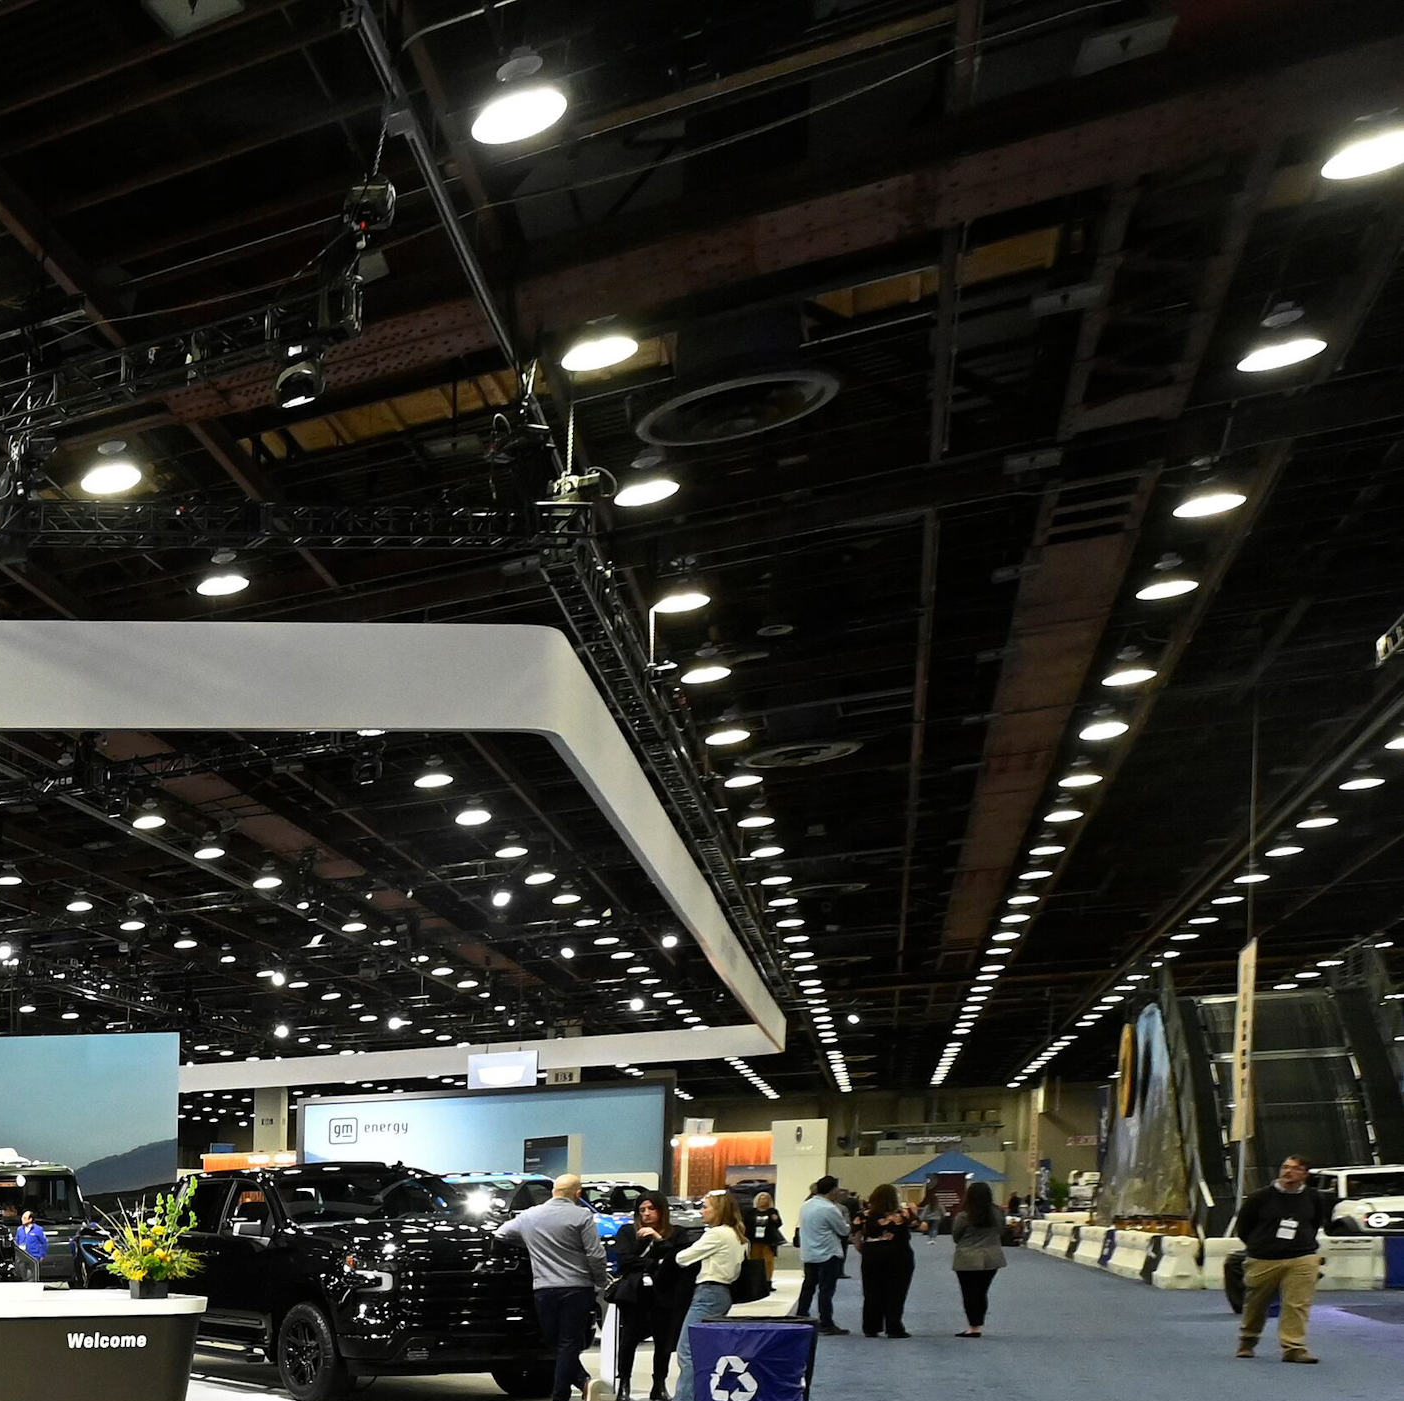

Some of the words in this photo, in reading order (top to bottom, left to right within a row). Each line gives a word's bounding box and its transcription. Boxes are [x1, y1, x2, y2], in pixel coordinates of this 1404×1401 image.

[334, 1123, 353, 1138] gm
[364, 1121, 409, 1135] energy
[906, 1135, 962, 1144] RESTROOMS
[67, 1331, 147, 1349] Welcome
